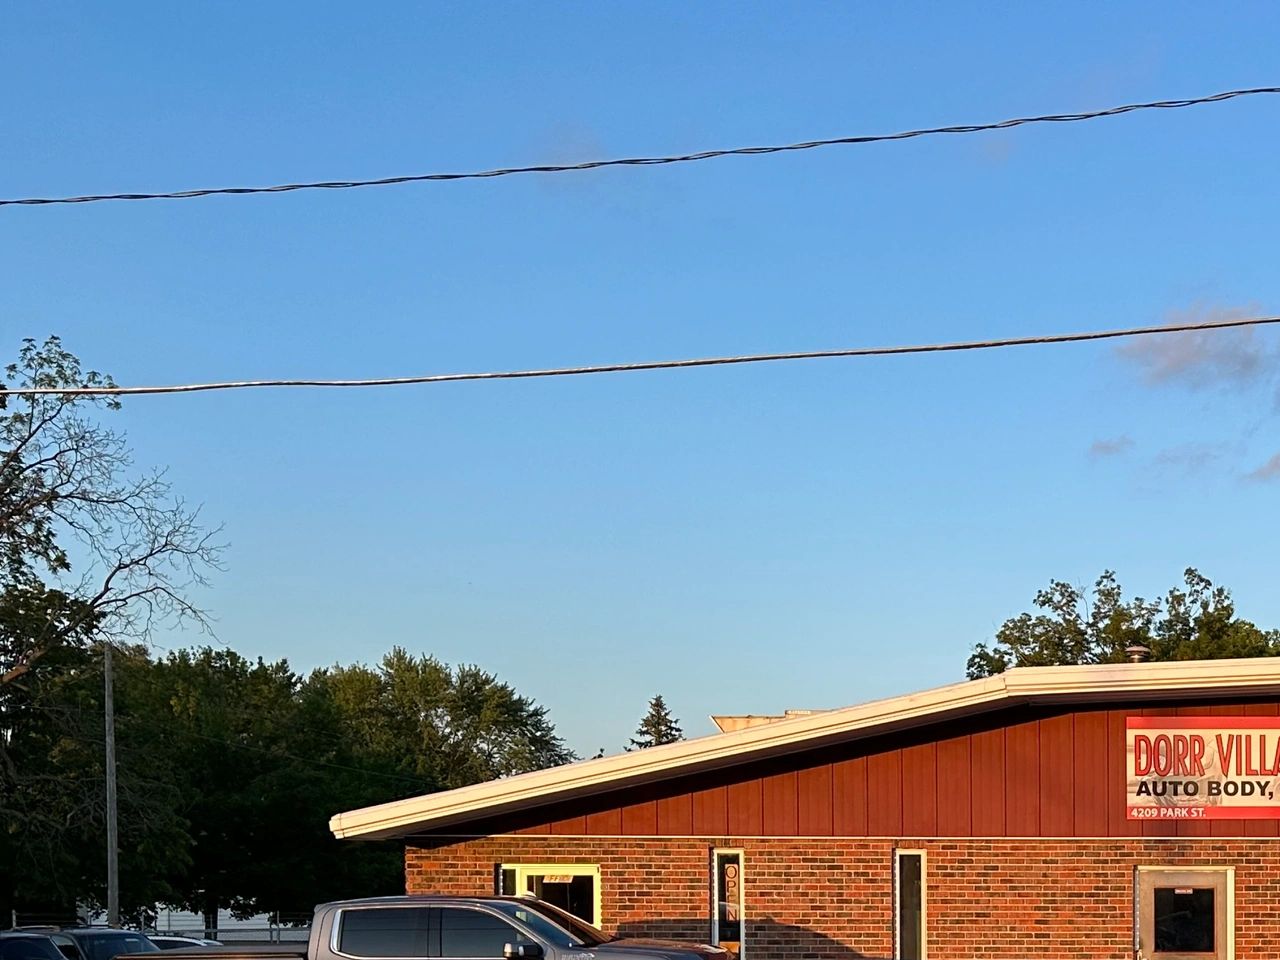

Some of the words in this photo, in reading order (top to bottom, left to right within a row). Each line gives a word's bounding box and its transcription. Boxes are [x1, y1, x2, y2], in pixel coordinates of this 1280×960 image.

[1134, 734, 1206, 777] DORR
[1136, 780, 1199, 797] AUTO
[1207, 780, 1274, 800] BODY,
[1131, 807, 1158, 817] 4209
[1160, 807, 1189, 817] PARK
[1190, 807, 1206, 817] ST.
